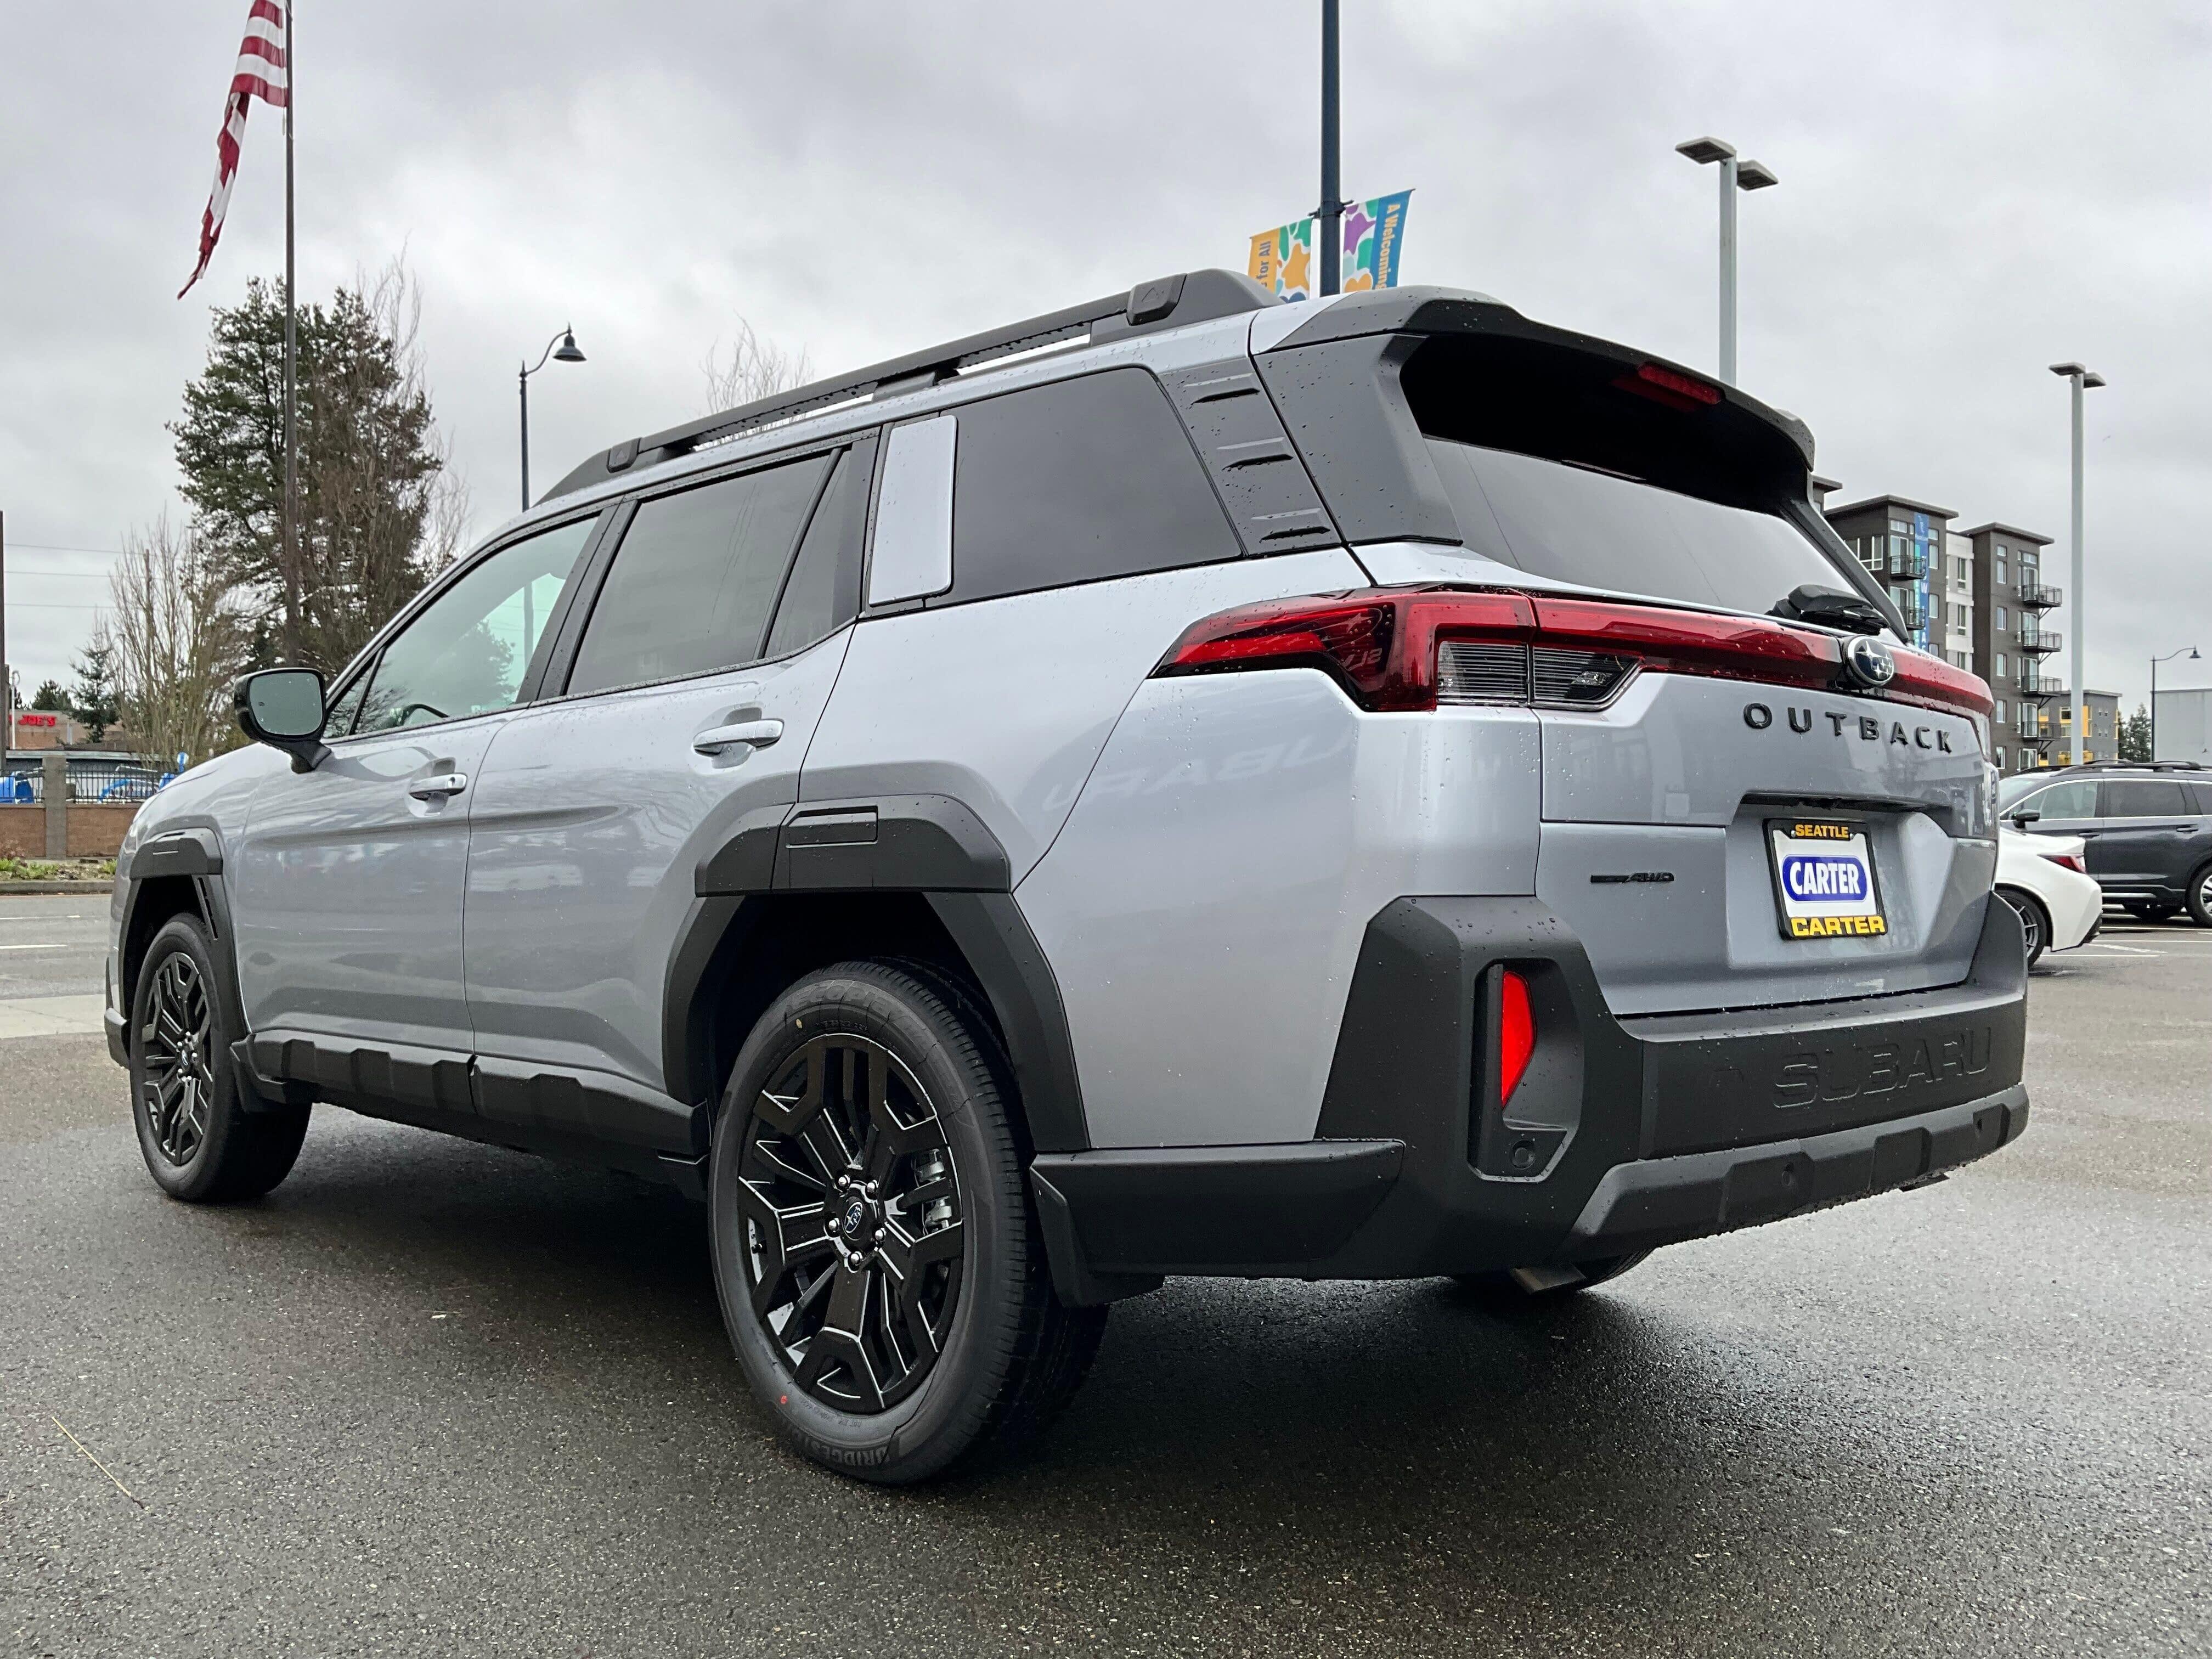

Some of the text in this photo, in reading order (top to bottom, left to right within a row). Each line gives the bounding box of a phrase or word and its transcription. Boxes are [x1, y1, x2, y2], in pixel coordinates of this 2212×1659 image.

[1258, 240, 1271, 257] All
[1376, 204, 1401, 289] A Welcoming
[1256, 261, 1269, 280] for
[18, 714, 57, 727] JOE'S
[1743, 702, 1952, 754] OUTBACK
[1795, 823, 1849, 839] SEATTLE
[1790, 861, 1861, 895] CARTER
[1791, 915, 1886, 936] CARTER
[1773, 1026, 1991, 1108] SUBARU
